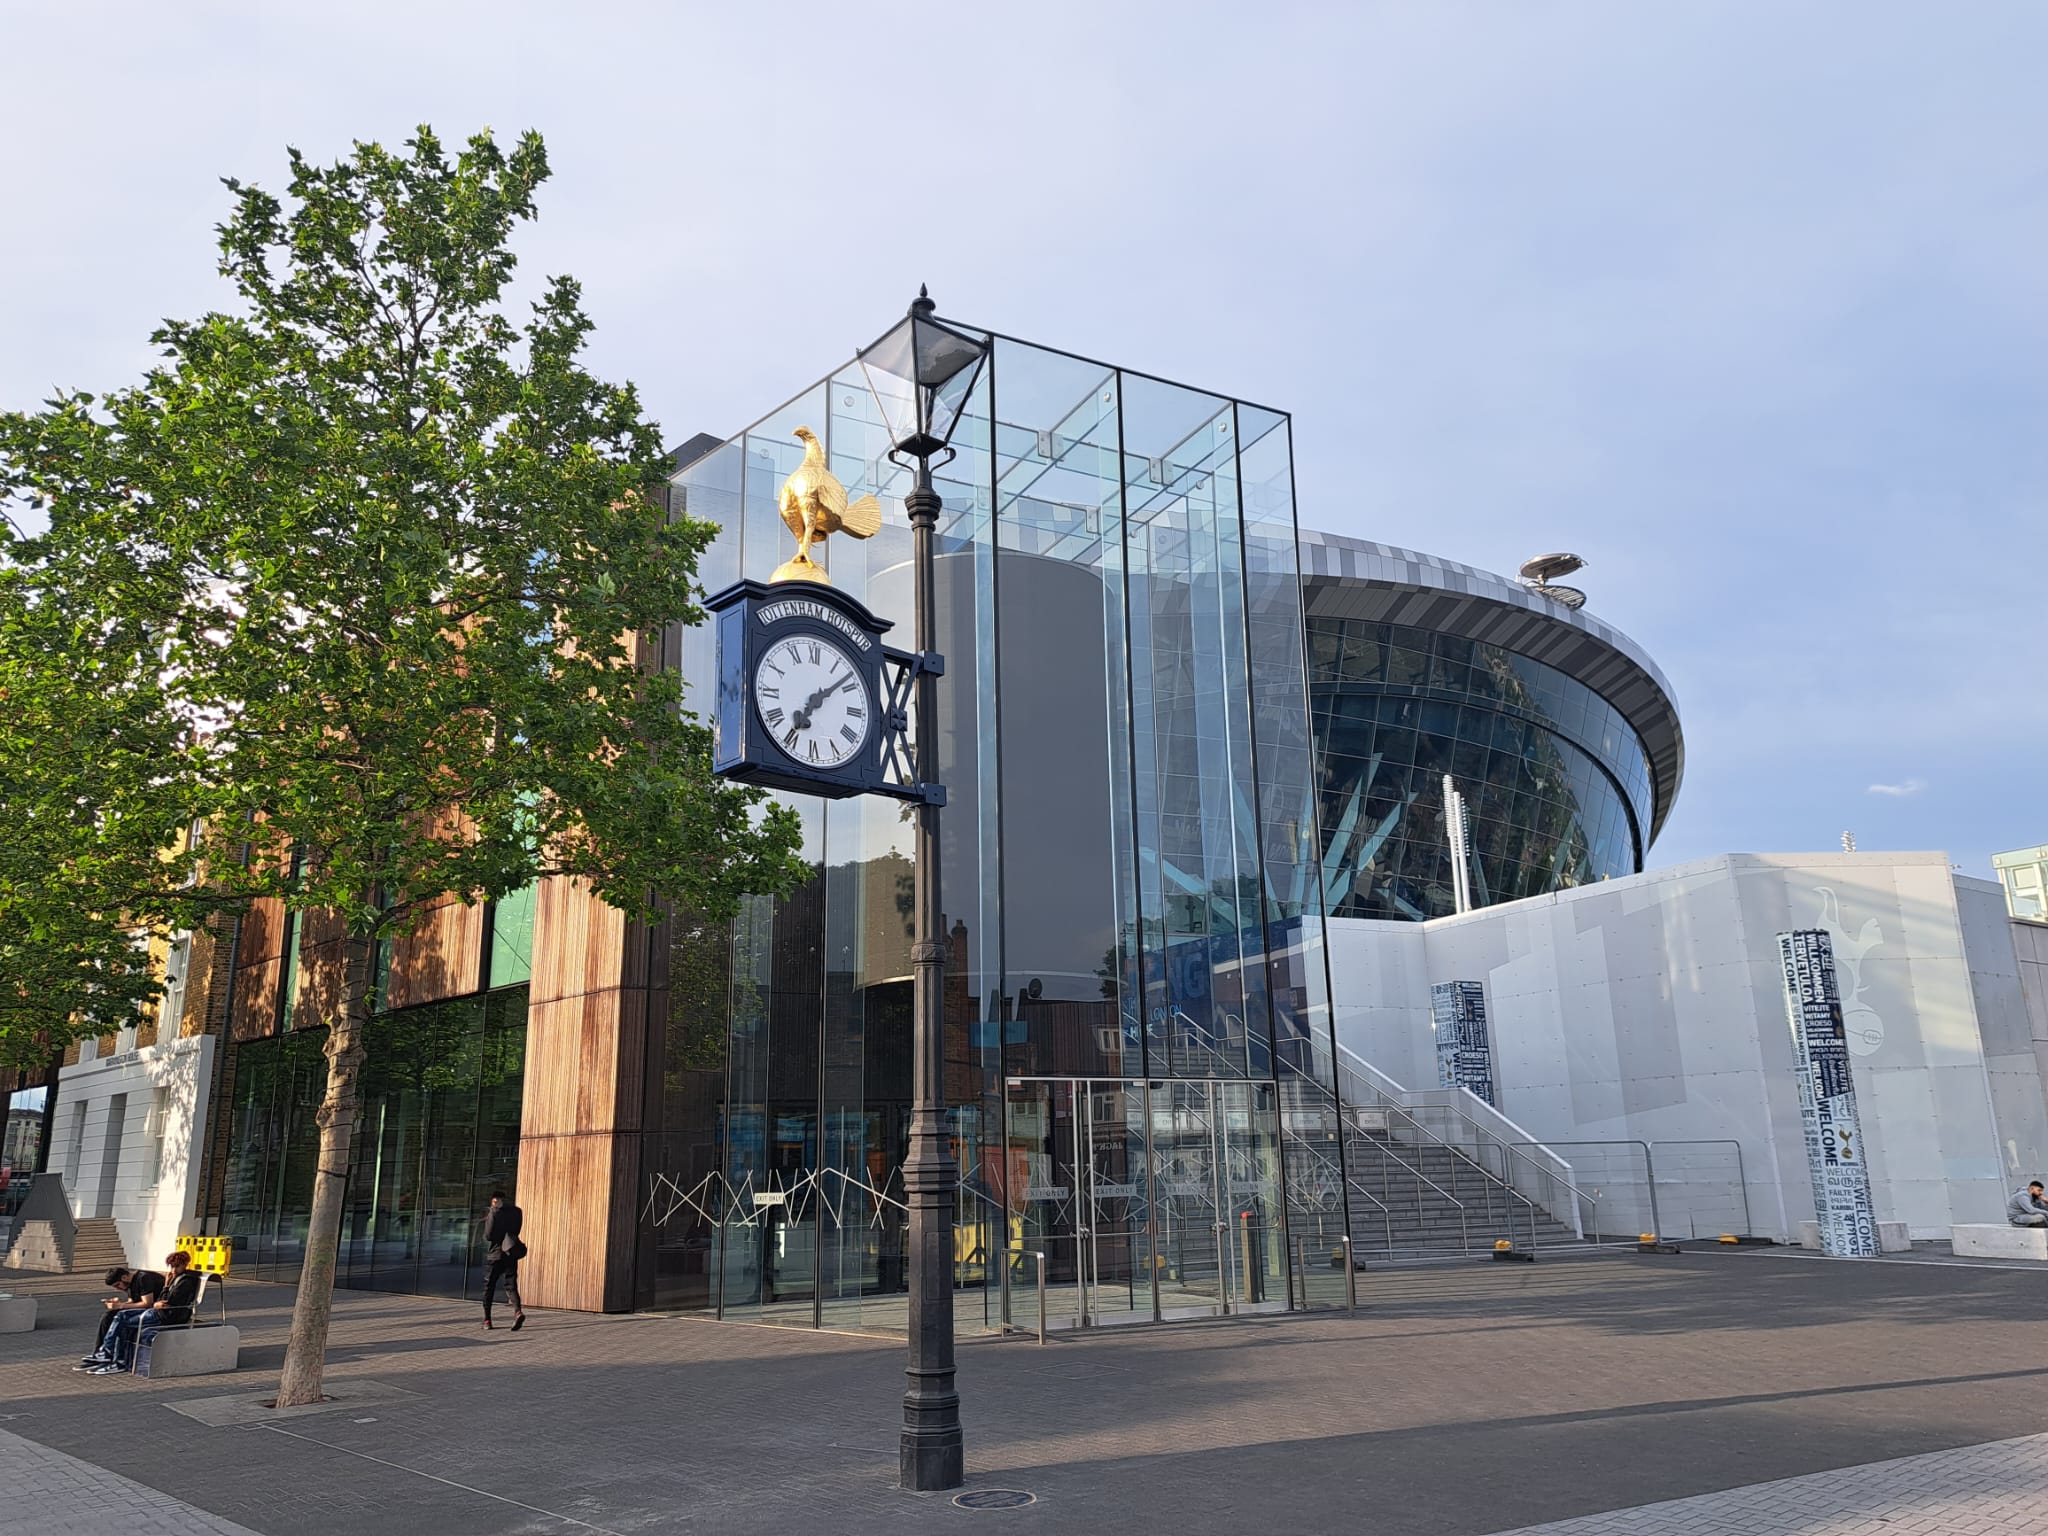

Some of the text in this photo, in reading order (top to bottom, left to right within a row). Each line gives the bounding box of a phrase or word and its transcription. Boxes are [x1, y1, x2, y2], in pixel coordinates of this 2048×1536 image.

[758, 602, 871, 651] TOTTENHAM HOTSPUR
[1781, 938, 1798, 995] WELCOME
[1794, 934, 1814, 1003] TERVETULOA
[1806, 933, 1826, 1003] WILLKOMMEN
[1150, 1003, 1182, 1021] LONON
[1809, 1038, 1845, 1047] WELCOME
[1811, 1060, 1825, 1099] WELKOM
[1817, 1100, 1839, 1167] WELCOME
[1831, 1212, 1848, 1257] WELKOM
[1854, 1187, 1874, 1257] WELCOME
